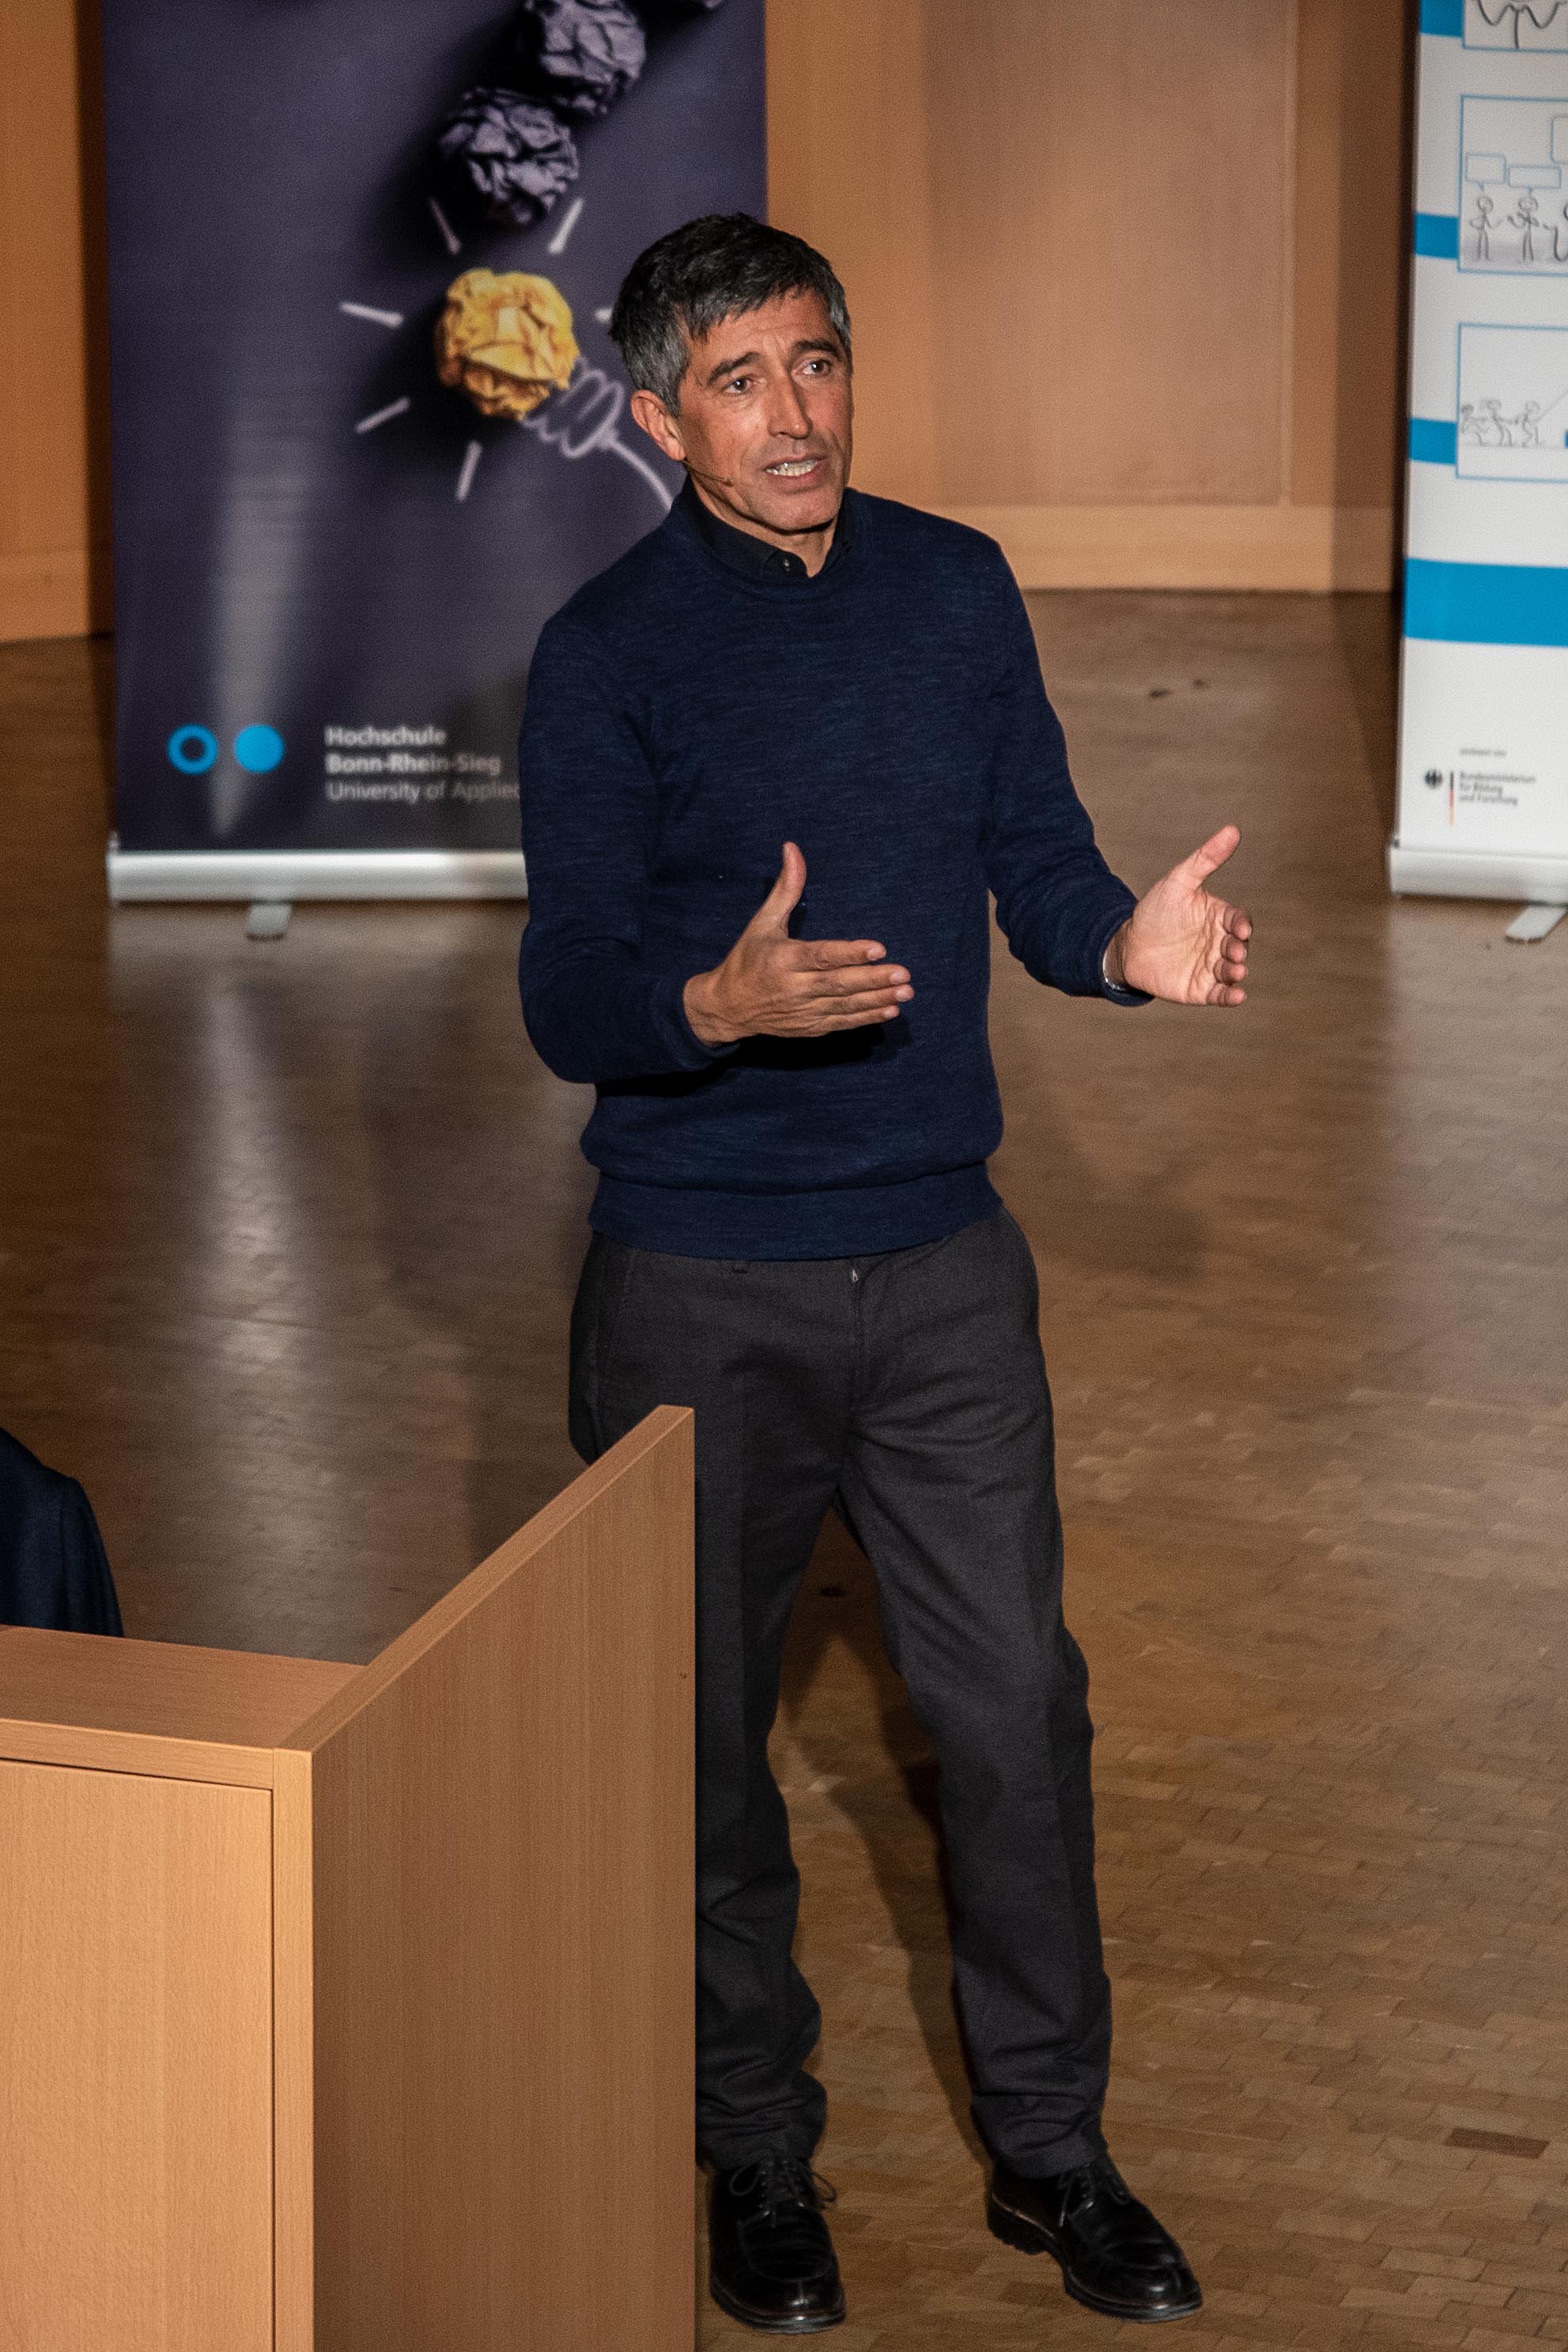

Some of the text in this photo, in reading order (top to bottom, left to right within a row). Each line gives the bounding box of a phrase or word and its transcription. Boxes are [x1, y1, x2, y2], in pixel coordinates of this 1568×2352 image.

[325, 725, 447, 747] Hochschule
[326, 752, 501, 776] Bonn-Rhein-Sieg
[327, 782, 420, 804] University
[425, 781, 446, 800] of
